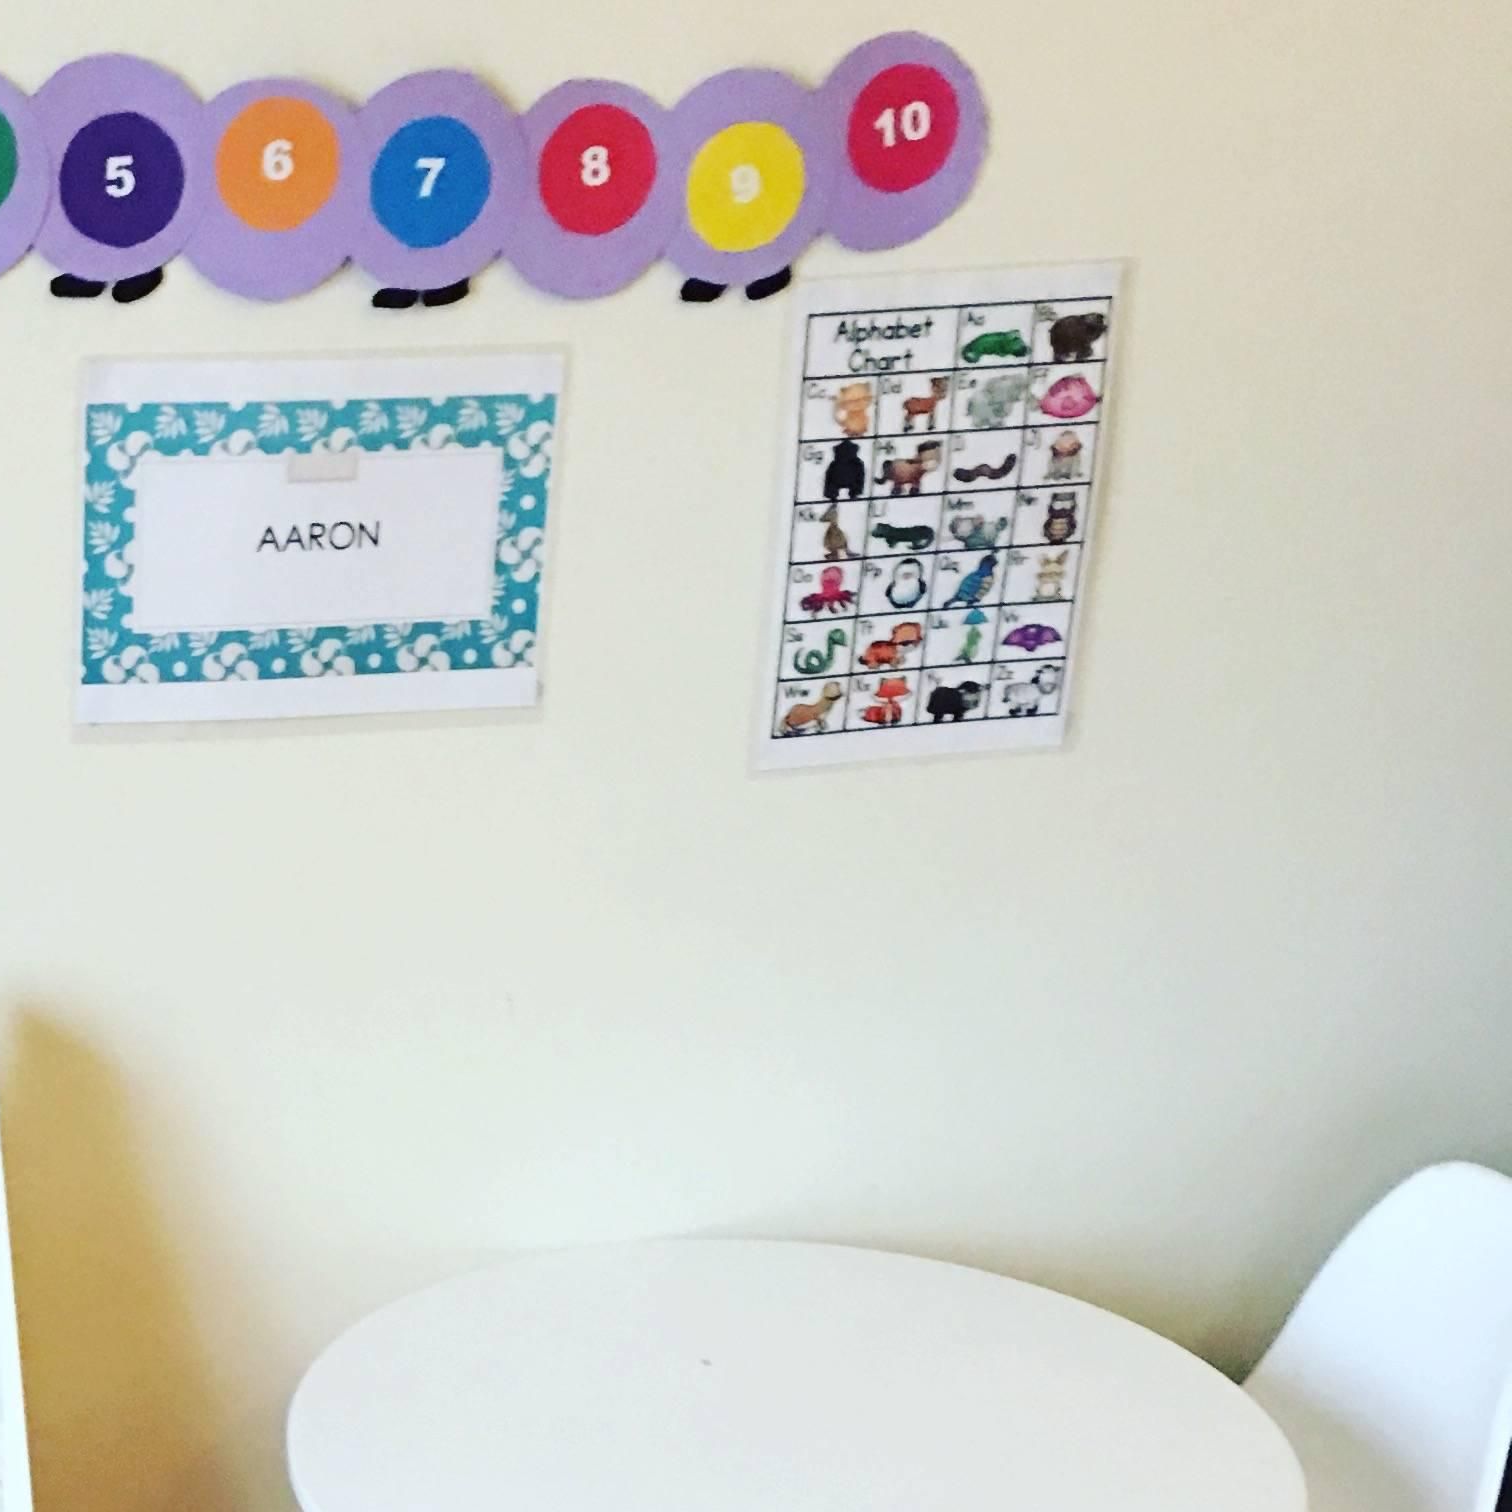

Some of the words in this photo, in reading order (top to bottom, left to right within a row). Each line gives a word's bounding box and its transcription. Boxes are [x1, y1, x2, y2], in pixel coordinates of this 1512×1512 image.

[872, 100, 932, 148] 10
[105, 156, 136, 197] 5
[263, 139, 294, 182] 6
[416, 157, 445, 197] 7
[580, 146, 610, 187] 8
[730, 164, 760, 204] 9
[835, 317, 935, 347] Alphabet
[848, 349, 914, 373] Chart
[256, 520, 381, 553] AARON
